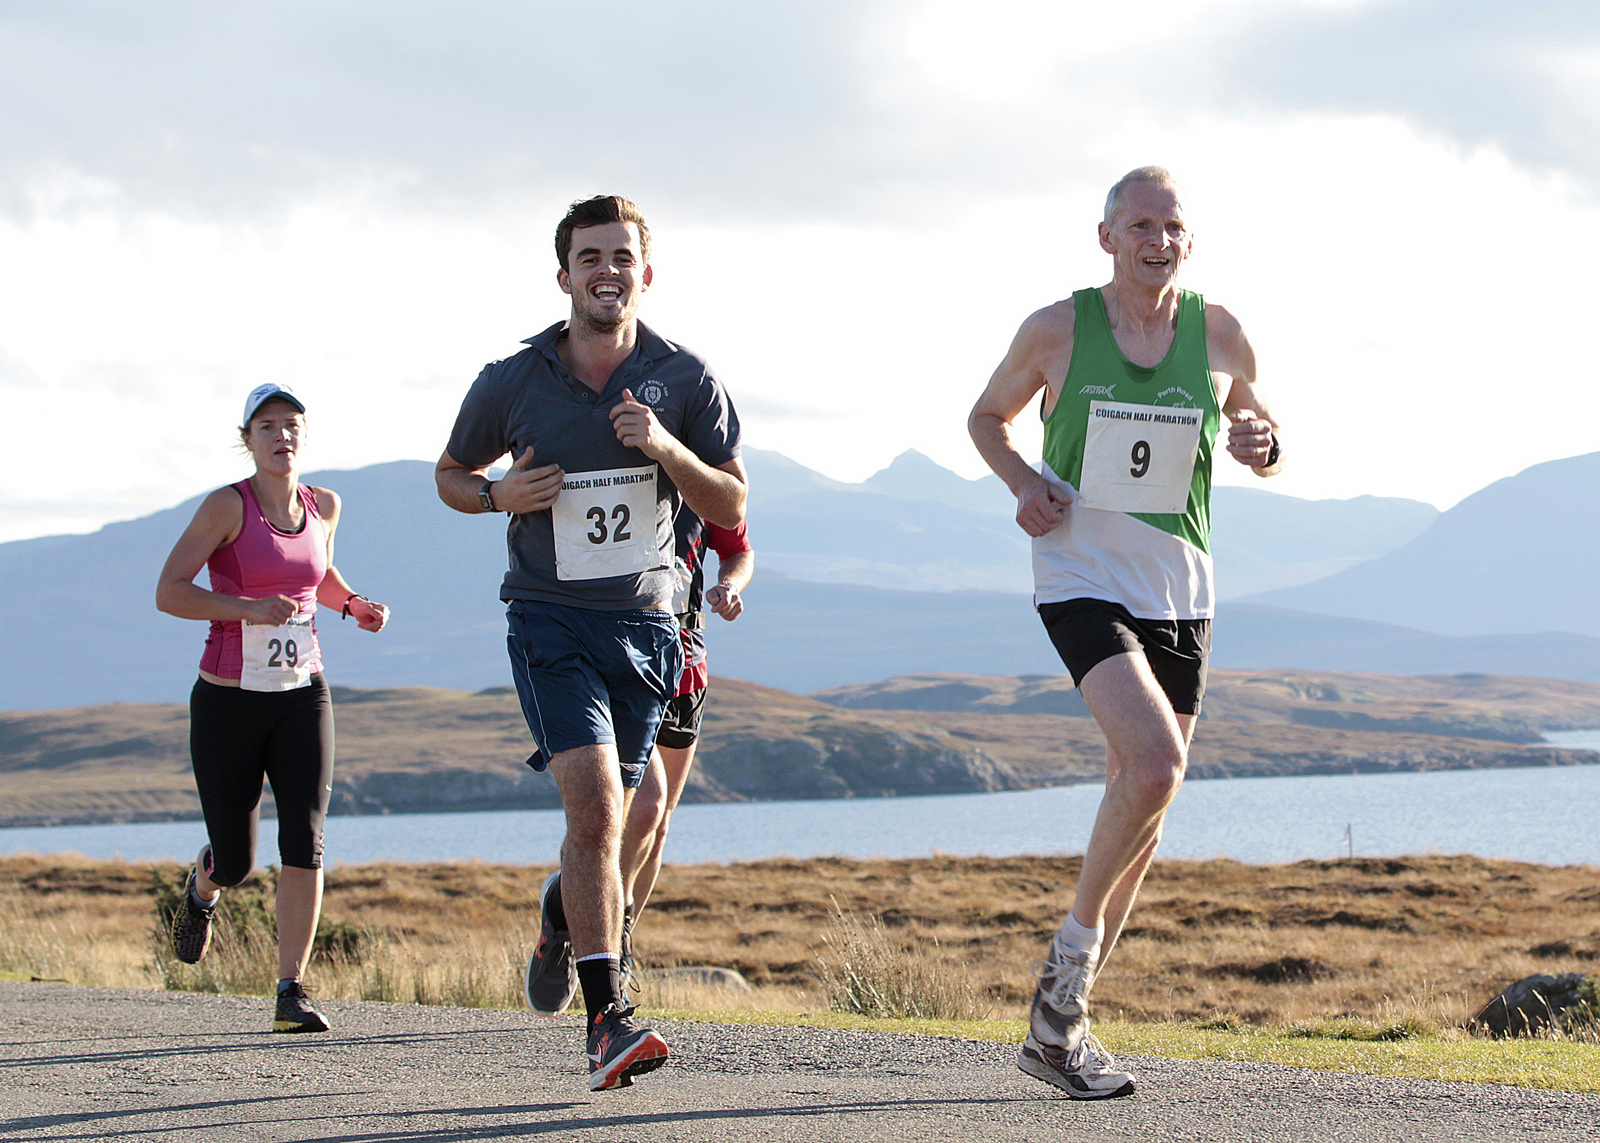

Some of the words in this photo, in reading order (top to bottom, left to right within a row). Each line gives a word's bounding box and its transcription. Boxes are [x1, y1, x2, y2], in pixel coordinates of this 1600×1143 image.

[1157, 386, 1175, 399] Perth
[1177, 386, 1193, 401] Road
[1095, 408, 1132, 420] COIGACH
[1133, 412, 1153, 422] HALF
[1154, 414, 1198, 426] MARATHON
[1130, 440, 1151, 478] 9
[560, 479, 591, 491] OIGACH
[593, 477, 611, 488] HALF
[613, 472, 654, 486] MARATHON
[586, 503, 631, 545] 32
[267, 638, 298, 668] 29
